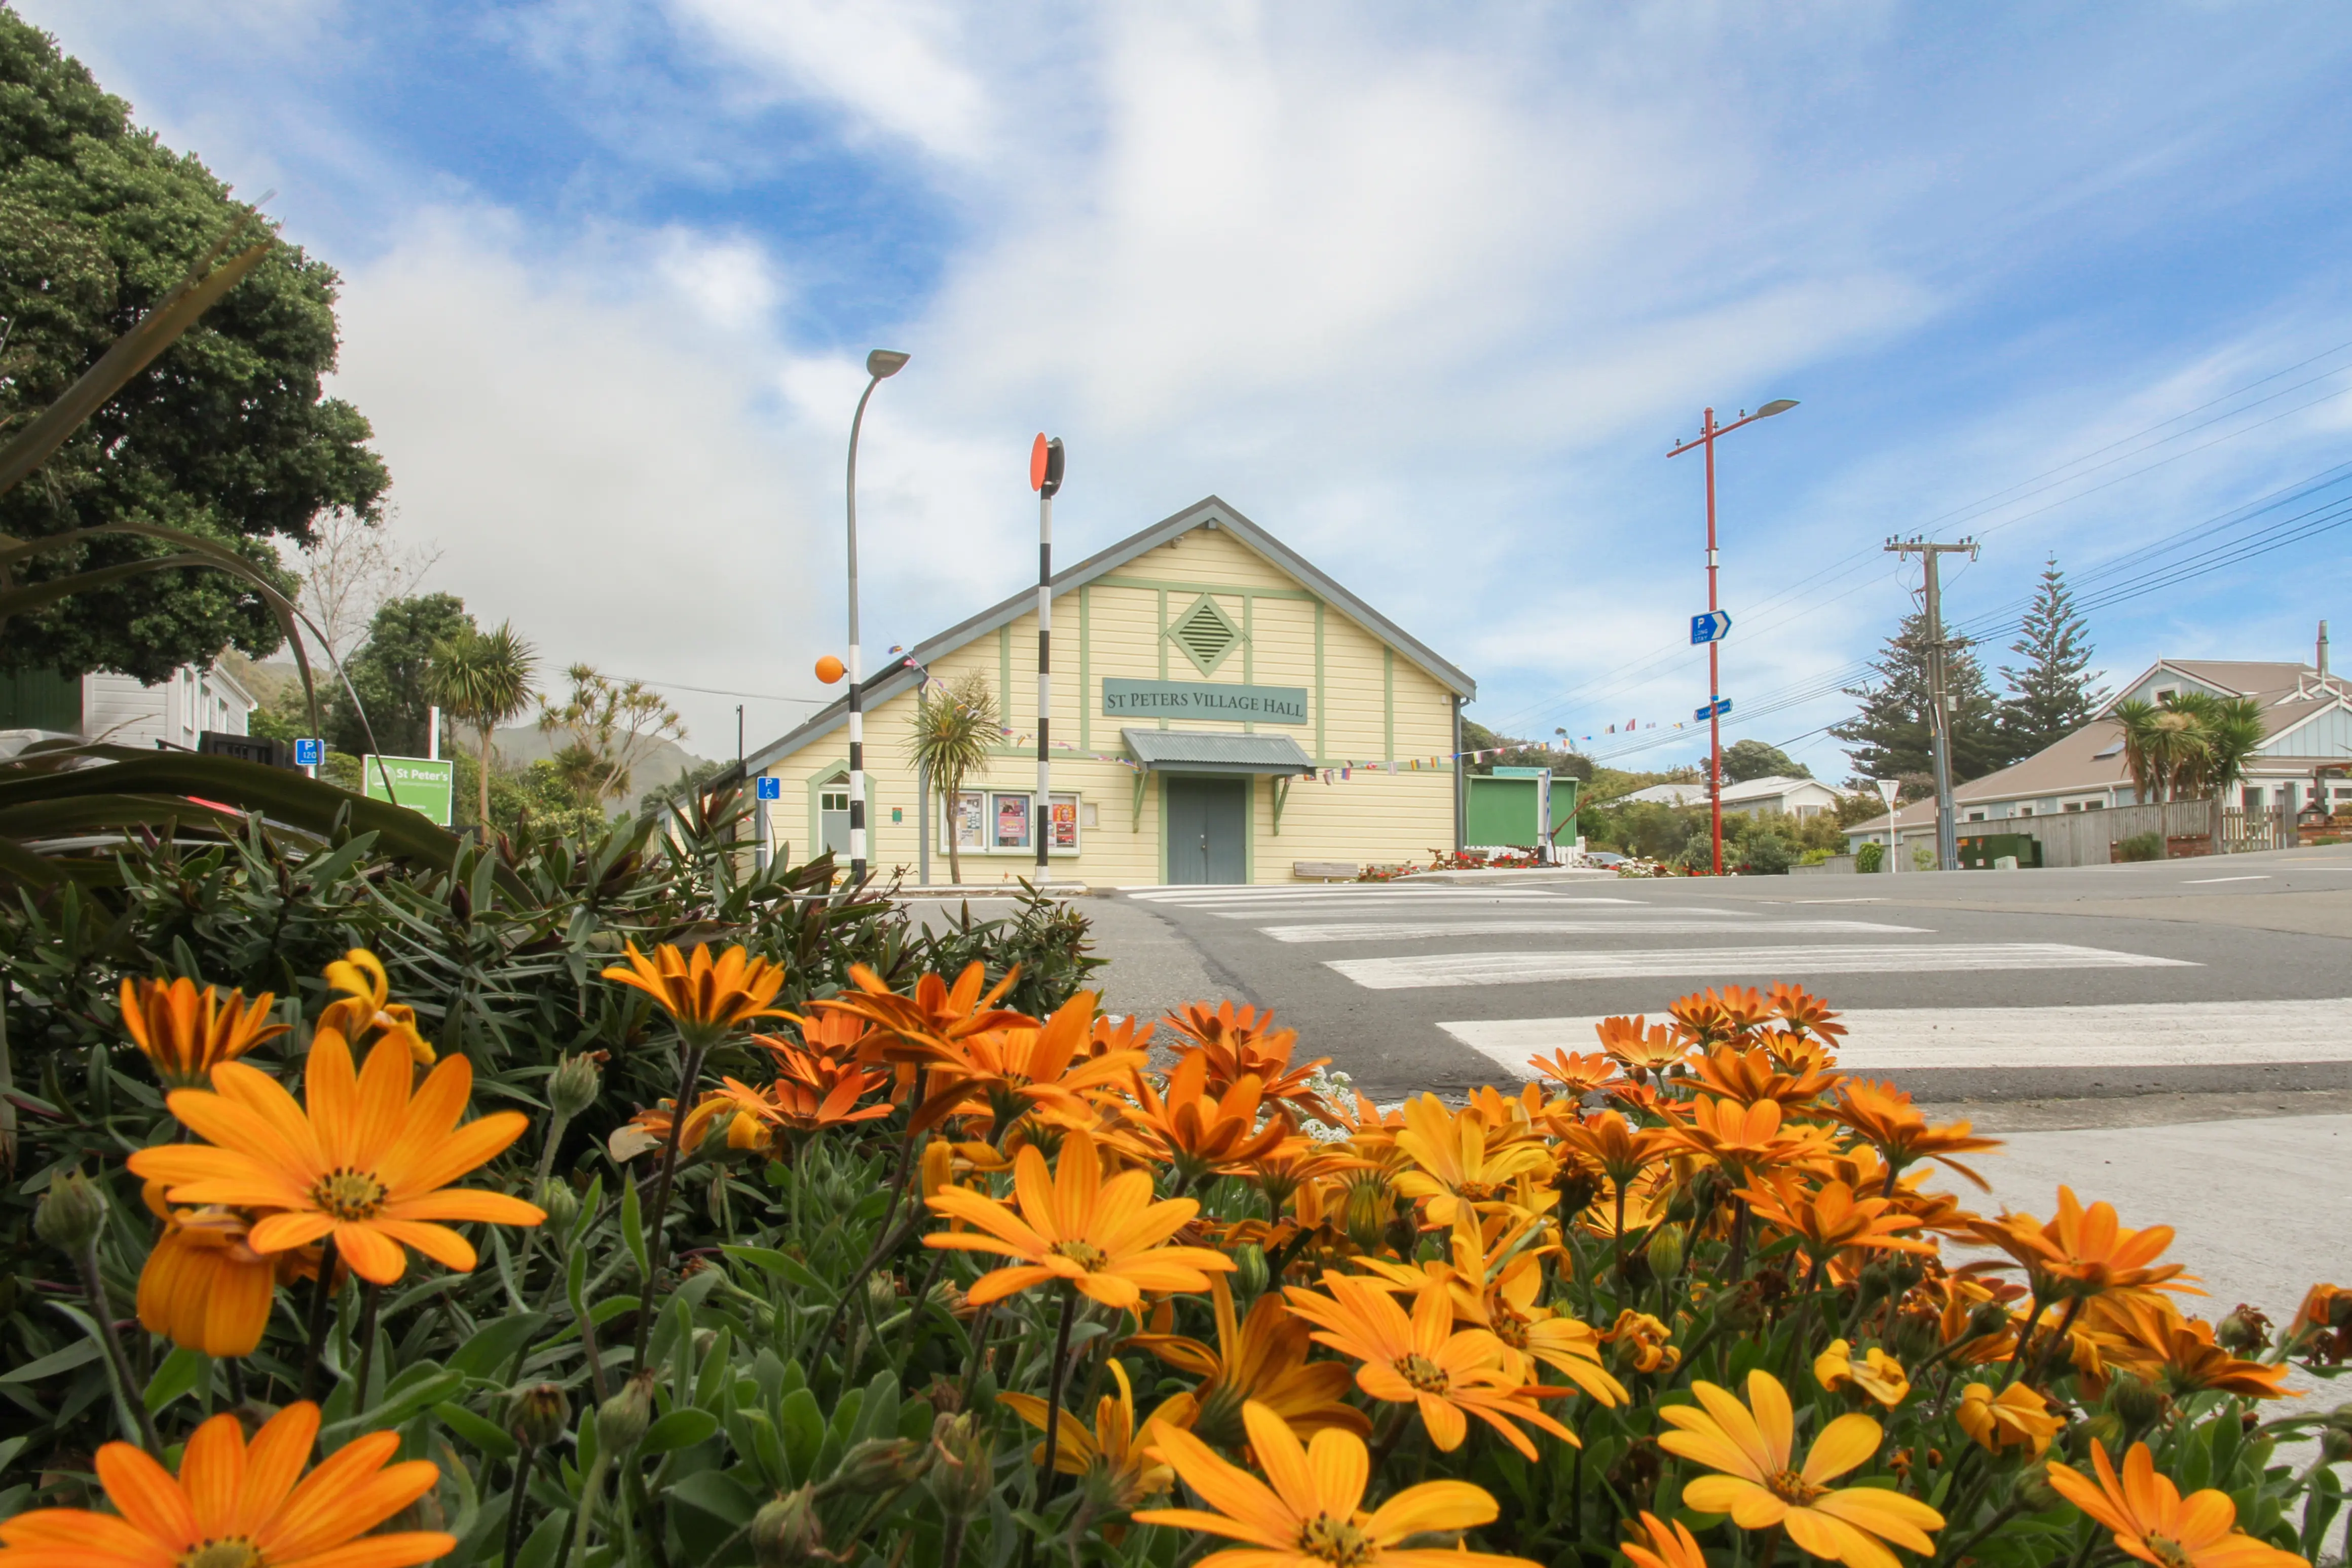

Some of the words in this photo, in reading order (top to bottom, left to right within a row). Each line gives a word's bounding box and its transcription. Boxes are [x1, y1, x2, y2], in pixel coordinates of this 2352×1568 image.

[1698, 618, 1705, 628] P
[1694, 629, 1708, 637] LONG
[1108, 694, 1126, 708] ST
[1193, 692, 1259, 710] VILLAGE
[1264, 698, 1303, 717] HALL
[305, 741, 314, 750] P
[396, 768, 408, 778] St
[411, 769, 449, 781] Peter's
